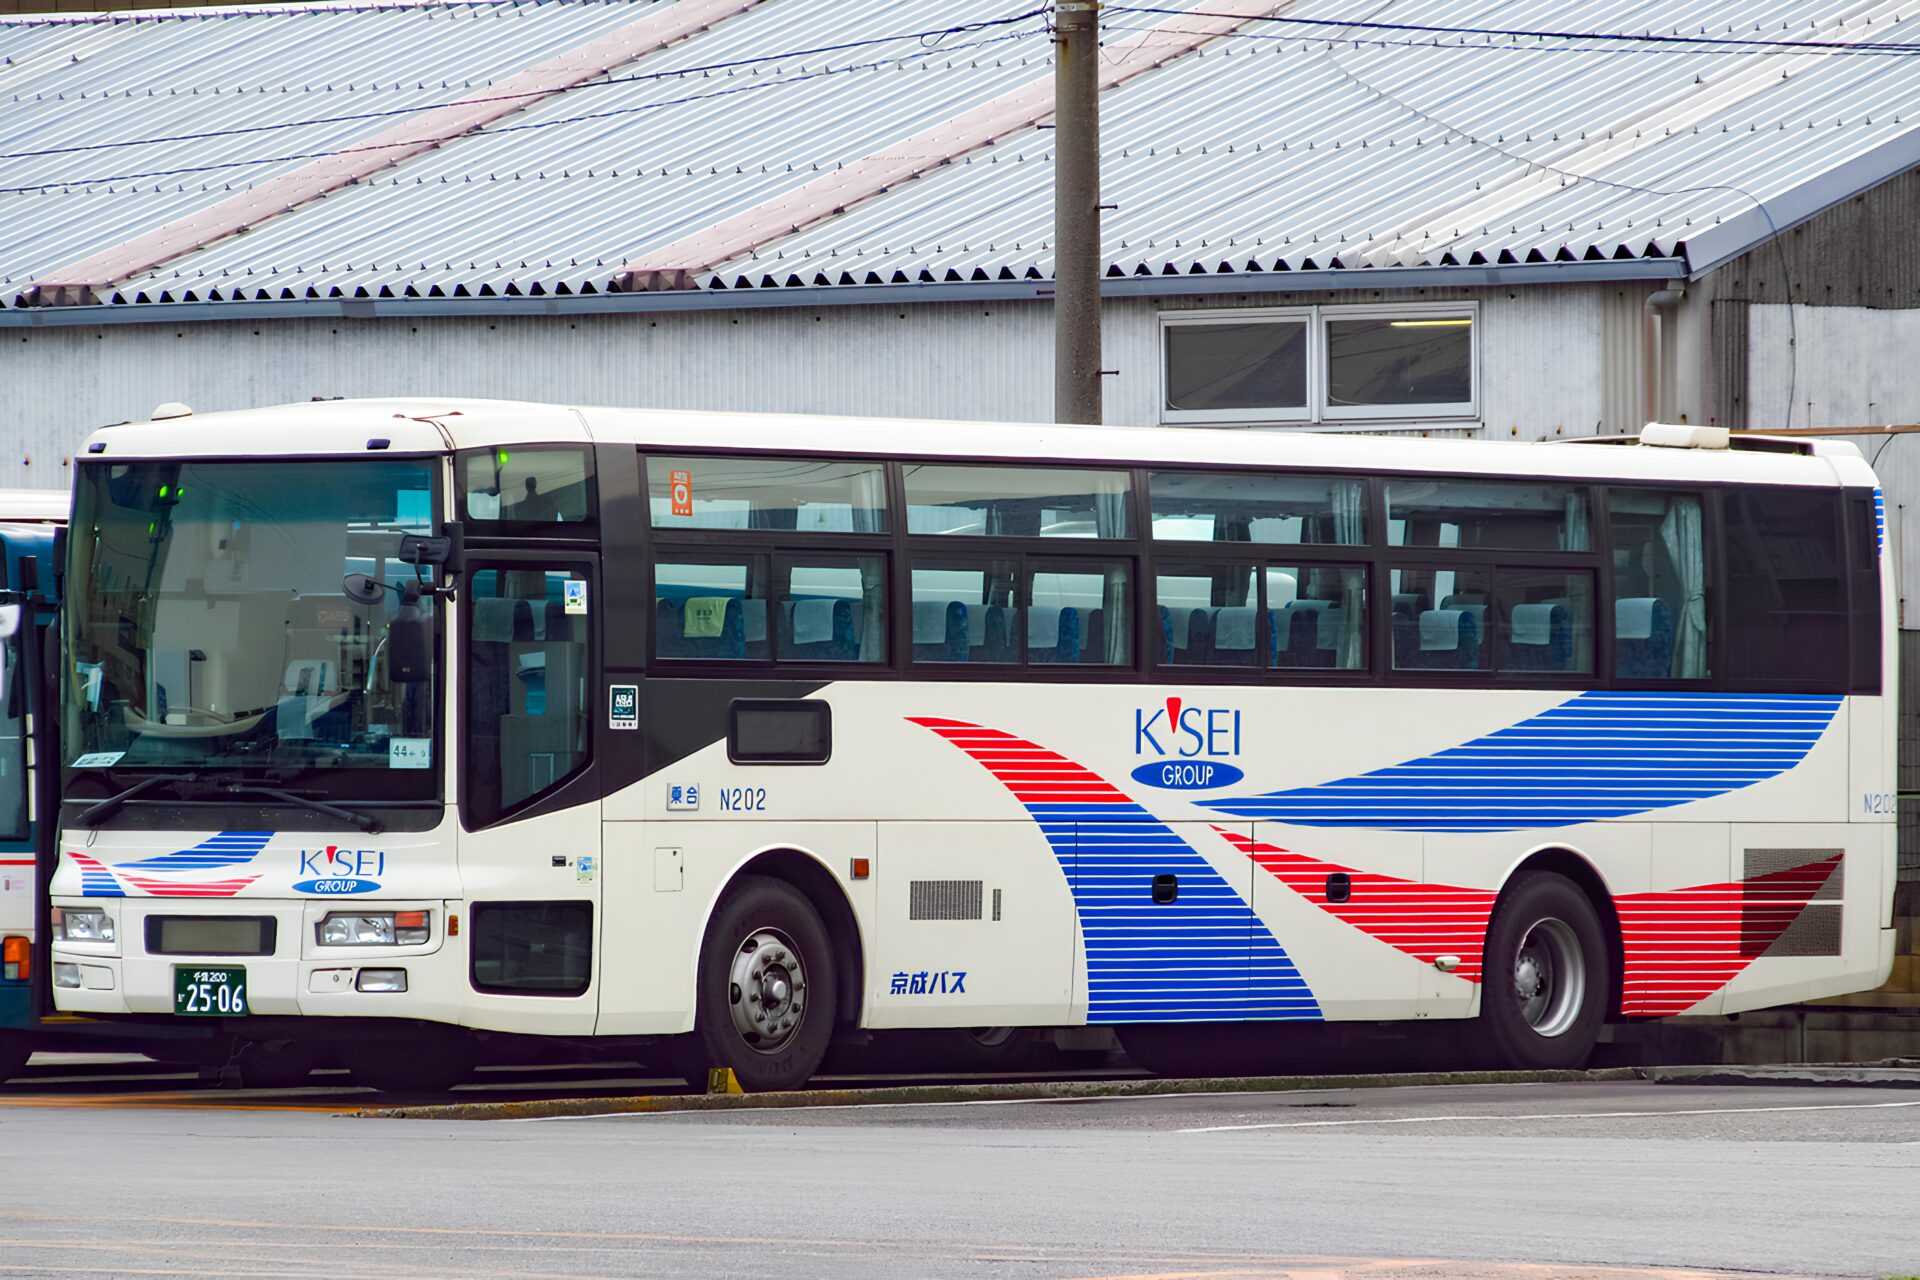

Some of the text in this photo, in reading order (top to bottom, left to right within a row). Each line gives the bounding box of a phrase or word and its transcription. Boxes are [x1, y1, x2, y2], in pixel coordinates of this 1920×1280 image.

[1162, 765, 1214, 786] GROUP
[720, 788, 766, 811] N202
[315, 880, 357, 892] GROUP
[890, 971, 967, 995] 京成バス
